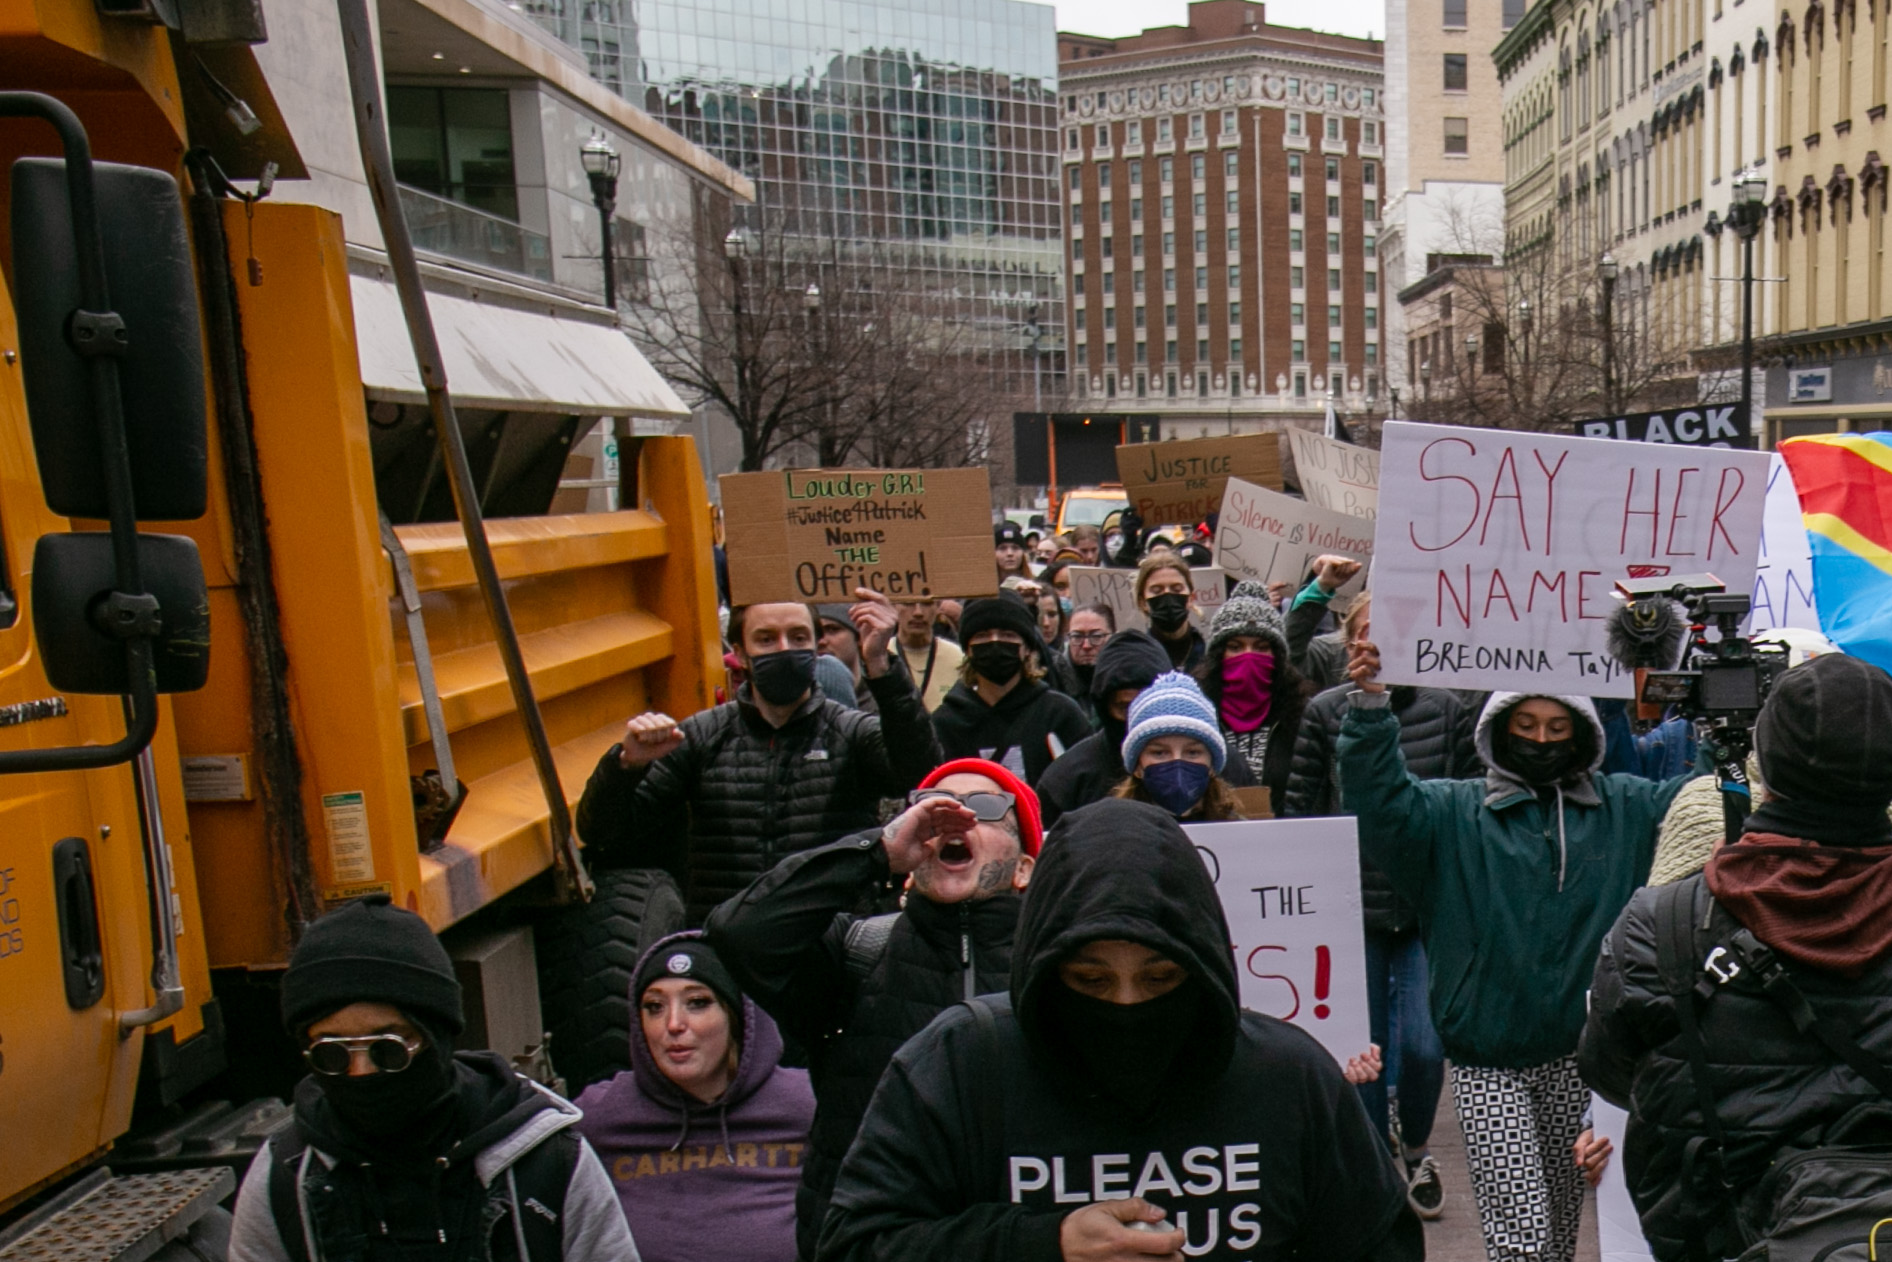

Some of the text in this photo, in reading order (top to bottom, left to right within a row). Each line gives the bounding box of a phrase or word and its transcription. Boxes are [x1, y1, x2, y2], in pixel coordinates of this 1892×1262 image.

[1583, 405, 1739, 444] BLACK
[1143, 449, 1232, 482] JUSTICE
[1299, 434, 1327, 471] NO
[786, 472, 876, 499] Louder
[1185, 478, 1209, 490] FOR
[1306, 478, 1332, 510] NO
[1410, 437, 1569, 556] SAY
[1619, 466, 1745, 561] HER
[786, 500, 926, 526] #Justice4Patrick
[1138, 496, 1220, 524] PATRICK
[1226, 491, 1285, 538] Silence
[1308, 522, 1374, 555] Violence
[825, 527, 887, 546] Name
[834, 547, 880, 564] THE
[795, 551, 932, 597] Officer!
[1437, 563, 1607, 629] NAME
[1415, 639, 1553, 675] BREONNA
[1251, 885, 1316, 919] THE
[612, 1141, 804, 1181] CARHARTT
[1009, 1143, 1260, 1203] PLEASE
[1176, 1203, 1262, 1257] US
